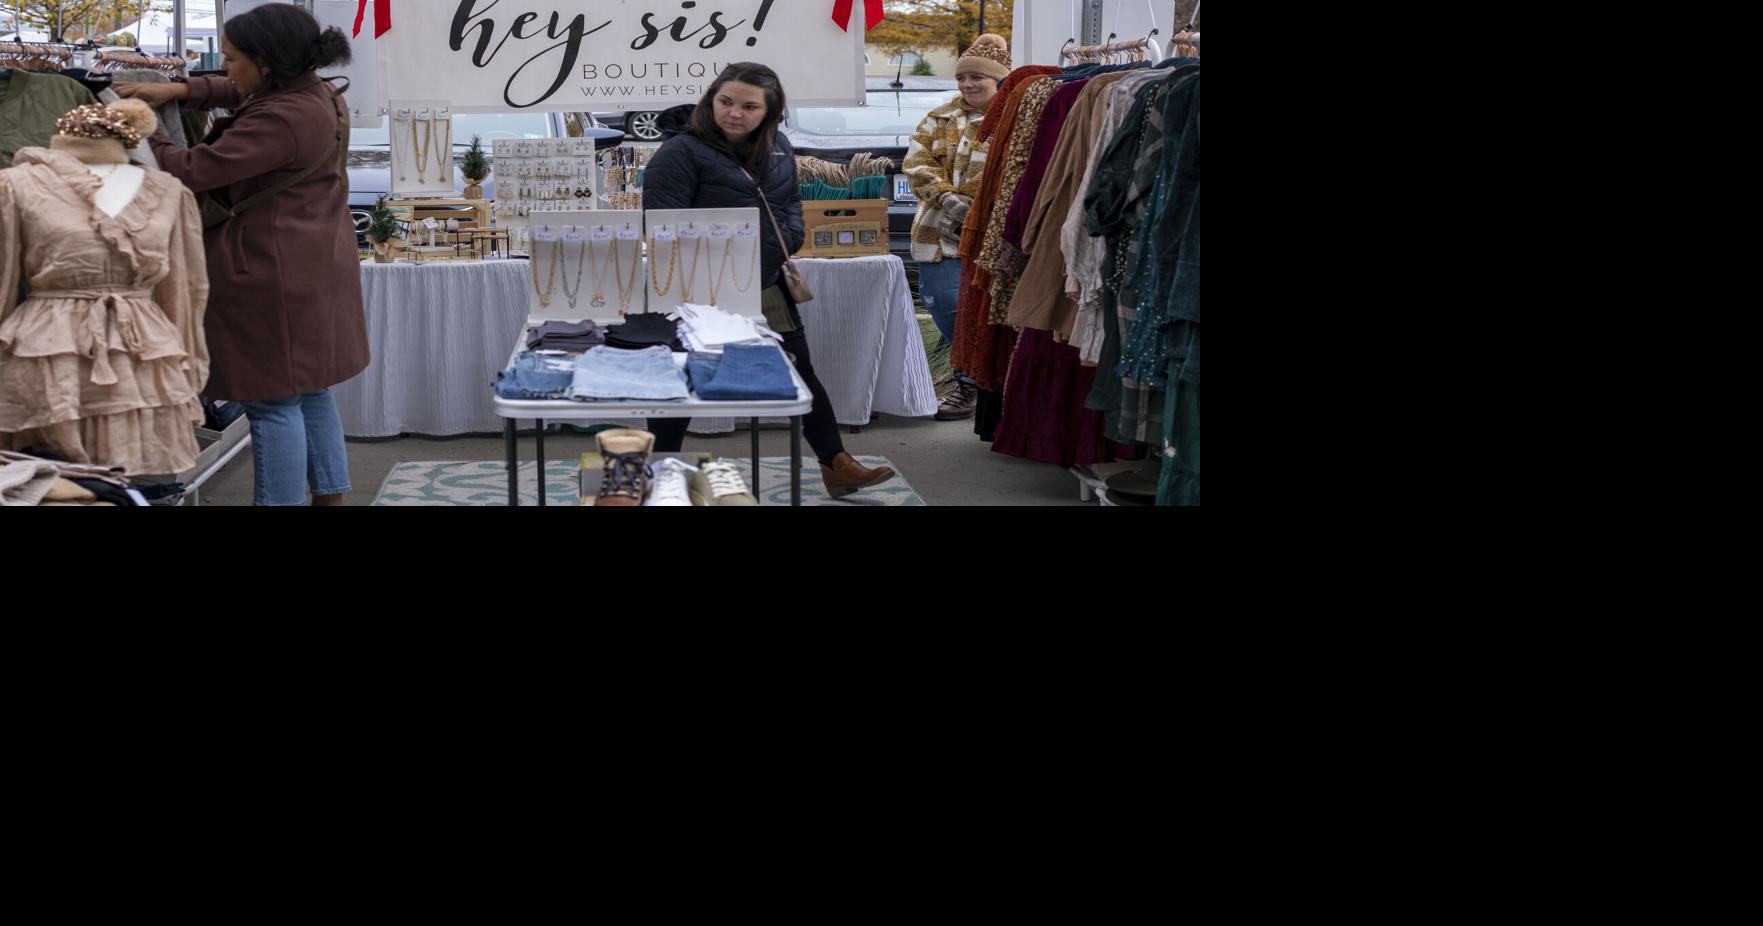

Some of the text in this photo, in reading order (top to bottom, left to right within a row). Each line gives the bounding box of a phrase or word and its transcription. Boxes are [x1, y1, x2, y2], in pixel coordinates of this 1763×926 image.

[449, 0, 774, 108] hey sis!
[583, 62, 729, 79] BOUTIQU
[581, 85, 711, 97] WWW.HEYSI
[897, 181, 913, 195] HL
